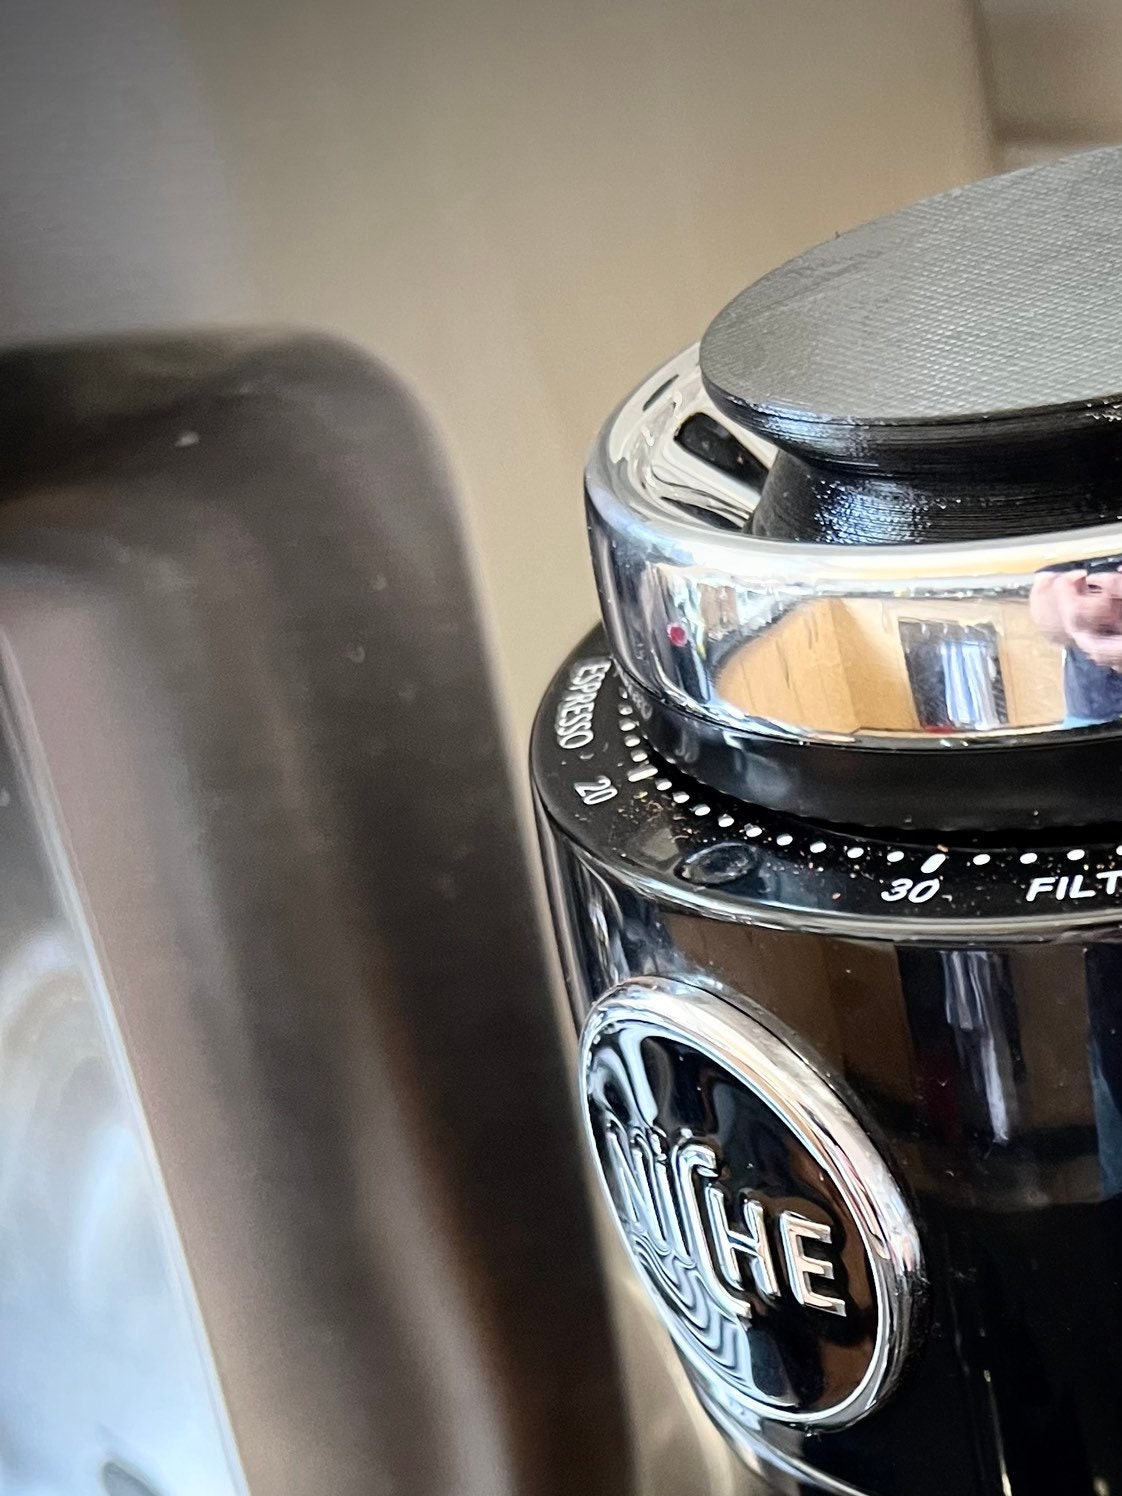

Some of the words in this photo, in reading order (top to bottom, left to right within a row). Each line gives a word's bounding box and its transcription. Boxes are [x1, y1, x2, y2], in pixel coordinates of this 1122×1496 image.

[554, 659, 613, 750] ESPRESSO
[573, 774, 619, 806] 20
[880, 878, 941, 904] 30
